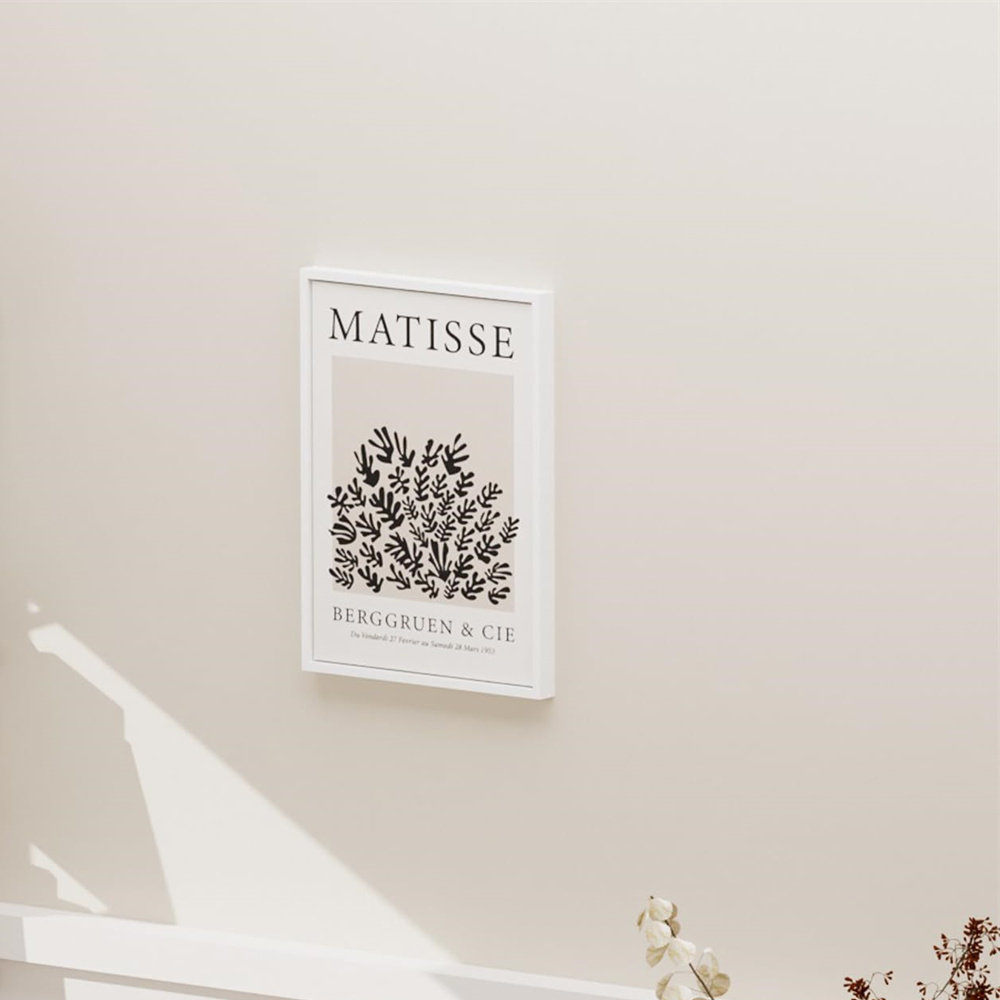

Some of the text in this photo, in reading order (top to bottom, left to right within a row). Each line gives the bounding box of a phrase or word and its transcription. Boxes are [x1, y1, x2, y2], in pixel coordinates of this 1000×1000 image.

[329, 307, 515, 359] MATISSE
[333, 606, 516, 643] BERGGRUEN & CIE
